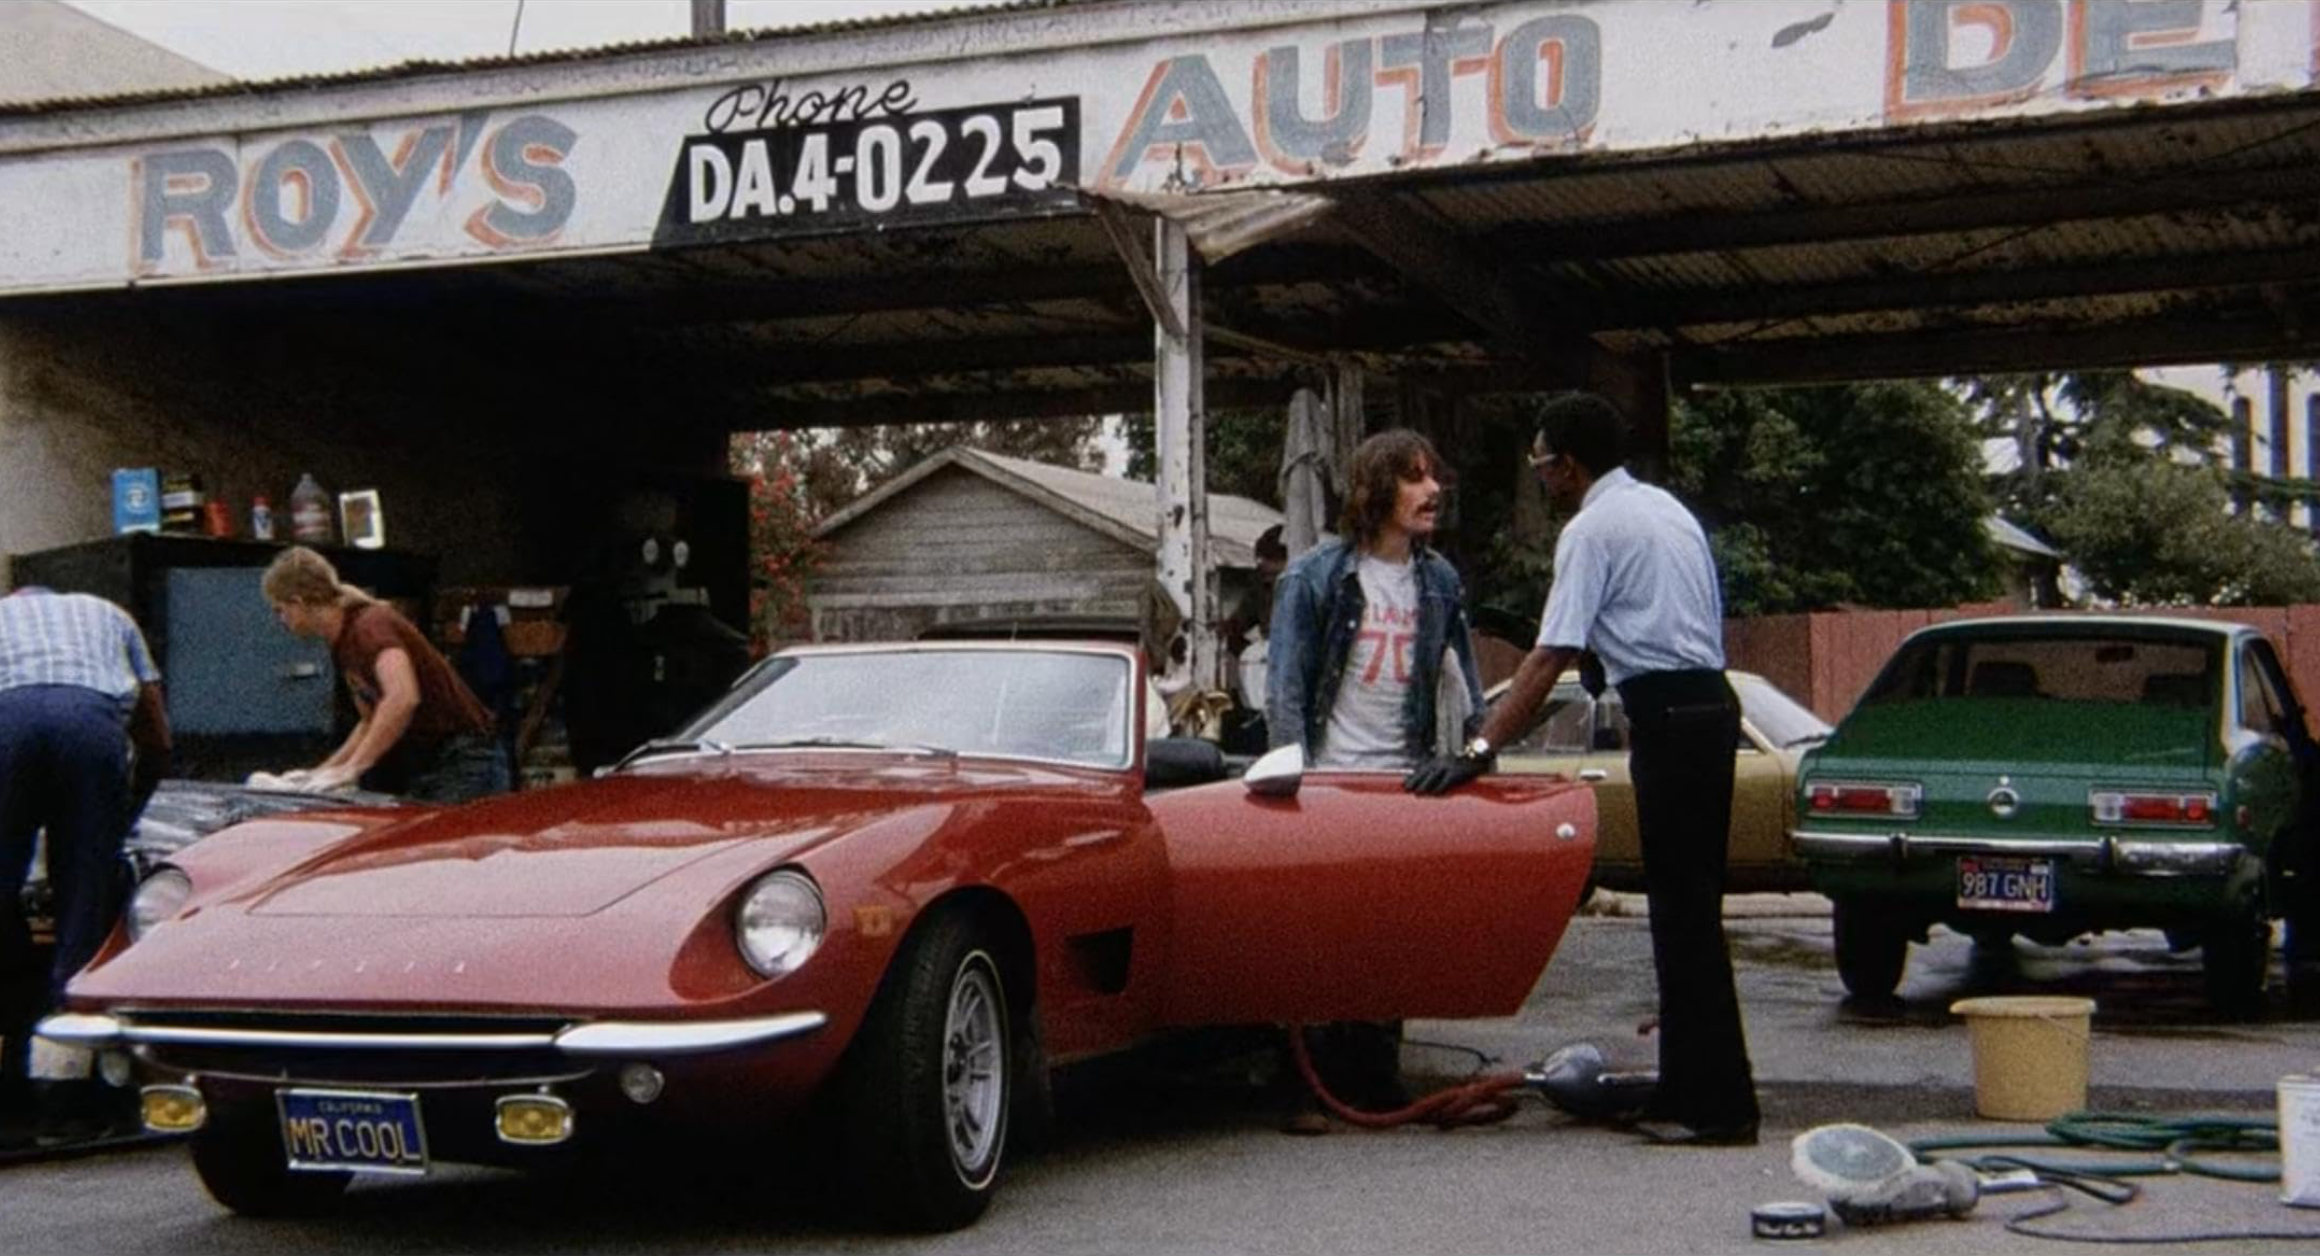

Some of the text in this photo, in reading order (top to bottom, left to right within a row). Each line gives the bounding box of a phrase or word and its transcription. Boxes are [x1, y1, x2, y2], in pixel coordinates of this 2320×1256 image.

[705, 78, 918, 133] Phone
[131, 111, 577, 277] ROY'S
[1099, 14, 1601, 191] AUTO
[689, 105, 1065, 224] DA.4-0225
[1963, 872, 2047, 900] 987 GNH
[288, 1117, 422, 1161] MR COOL
